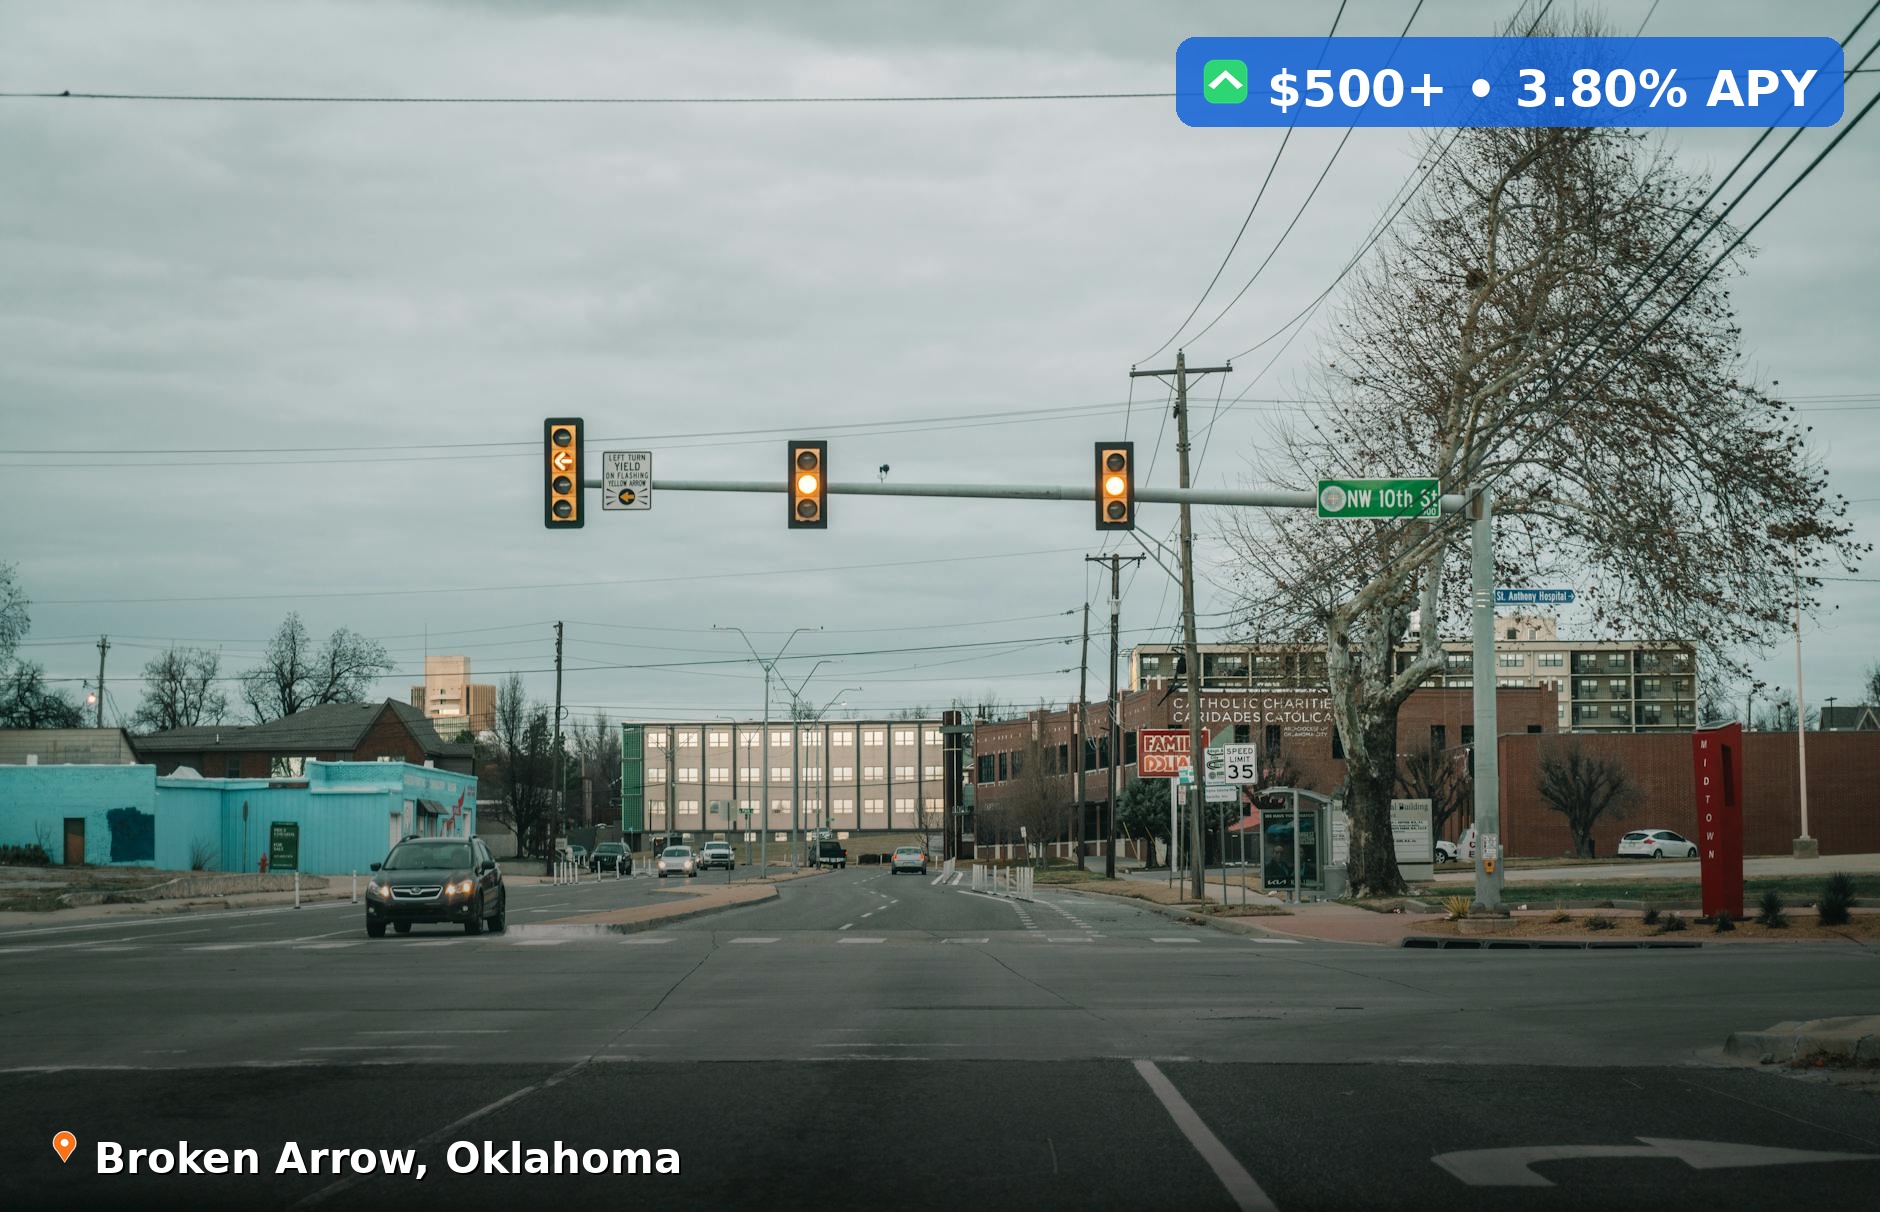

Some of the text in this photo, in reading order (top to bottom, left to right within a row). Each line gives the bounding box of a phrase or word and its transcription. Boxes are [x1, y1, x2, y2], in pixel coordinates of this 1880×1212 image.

[614, 462, 641, 471] YIELD
[1347, 488, 1438, 508] NW 10th St
[1496, 591, 1567, 603] St. Anthony Hospital
[1263, 698, 1332, 709] CHARITIE
[1265, 709, 1333, 723] CATÓLICA
[1143, 735, 1191, 752] FAMIL
[1143, 755, 1191, 772] DOLLA
[1228, 764, 1253, 779] 35
[1700, 739, 1715, 859] MIDTOWN
